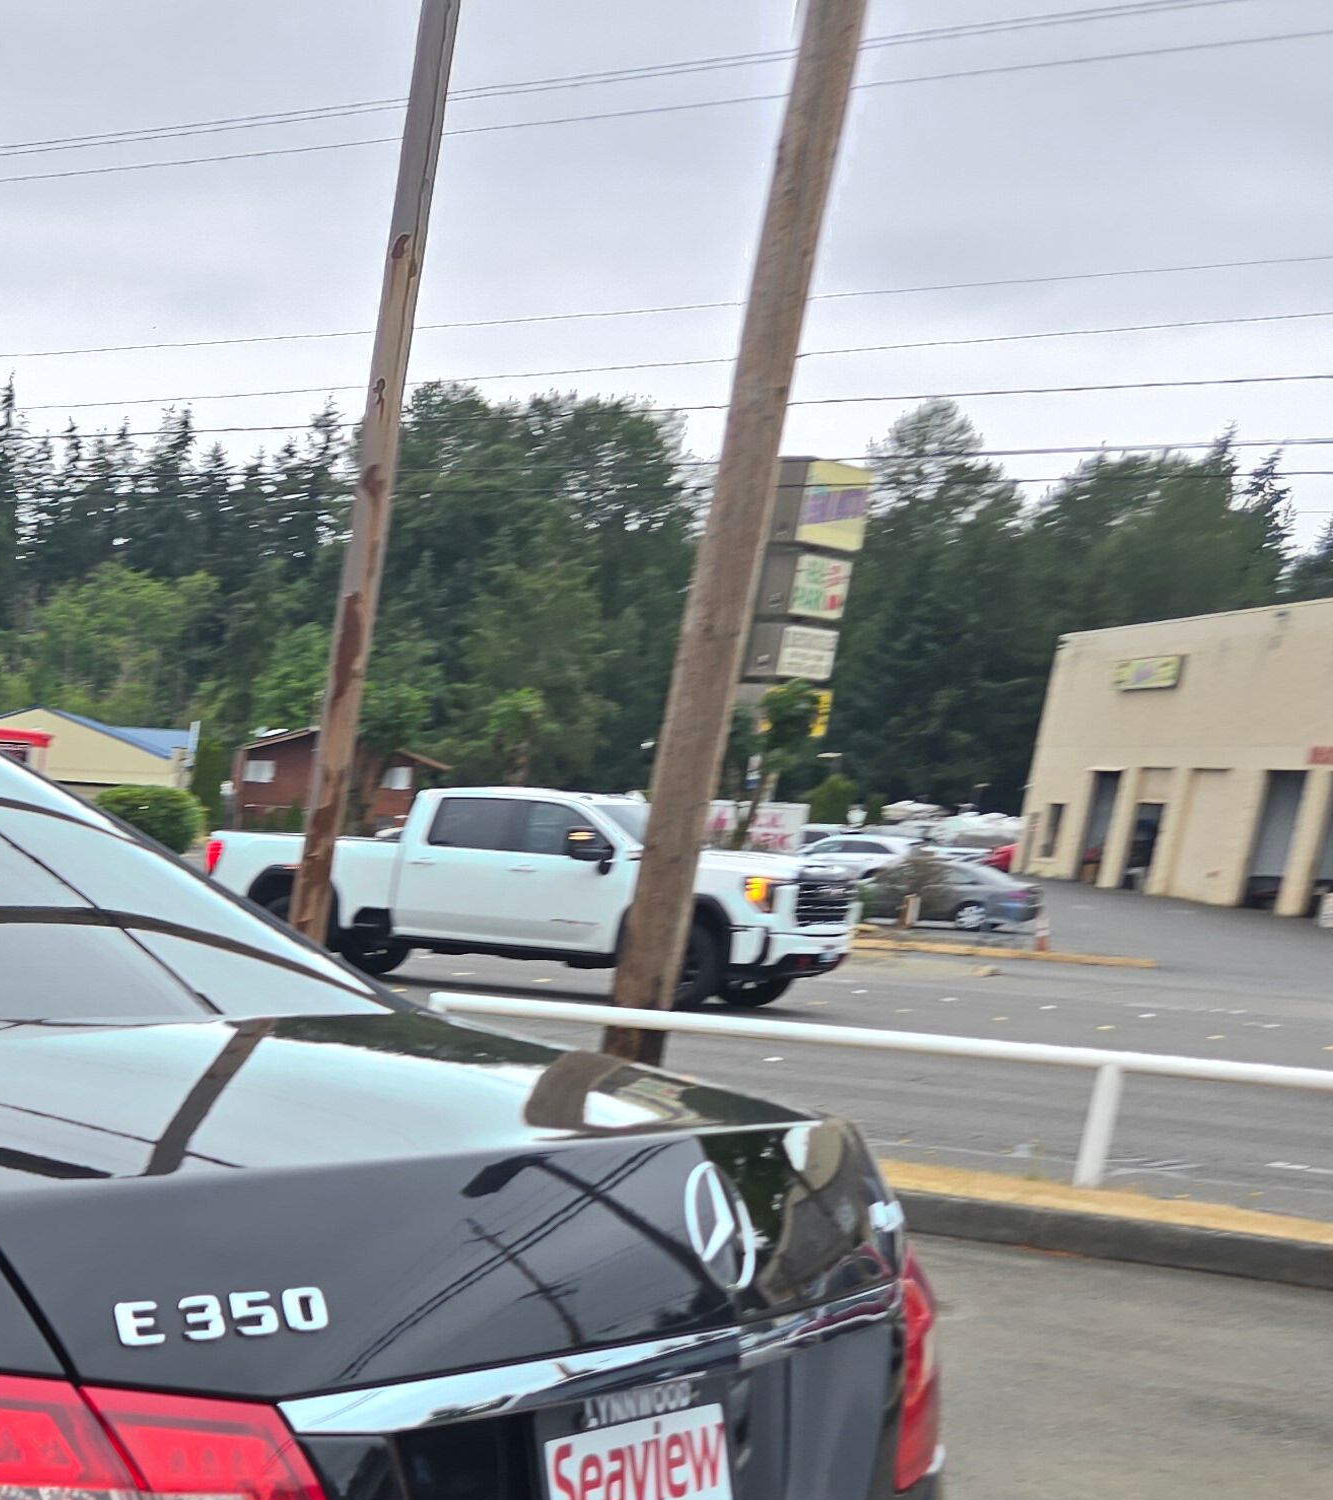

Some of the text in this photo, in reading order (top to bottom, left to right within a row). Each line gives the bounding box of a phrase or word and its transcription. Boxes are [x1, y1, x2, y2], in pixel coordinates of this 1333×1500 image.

[114, 1286, 329, 1346] E 350
[584, 1380, 693, 1429] LYNNWOOD
